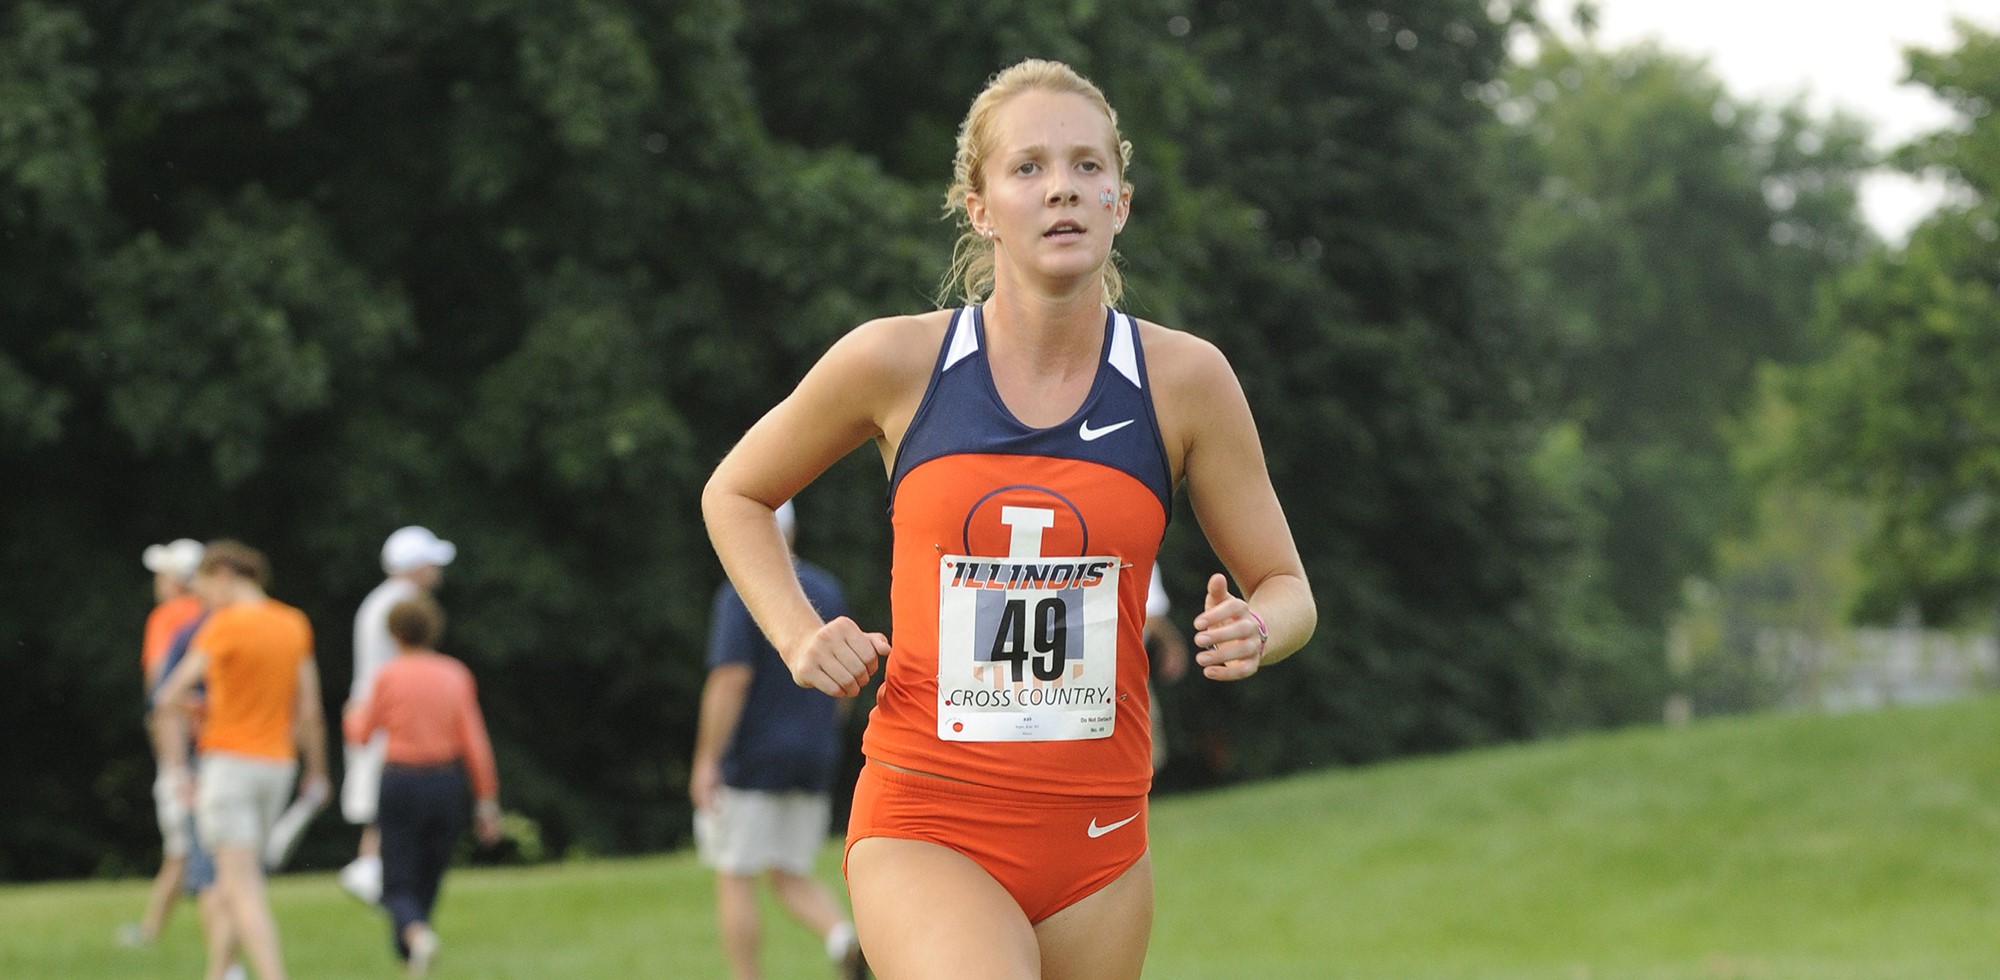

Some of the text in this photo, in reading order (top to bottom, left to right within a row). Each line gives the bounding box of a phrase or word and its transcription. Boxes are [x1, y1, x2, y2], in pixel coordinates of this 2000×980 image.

[950, 561, 1108, 590] ILLINOIS
[991, 597, 1067, 682] 49
[950, 687, 1109, 707] CROSS COUNTRY
